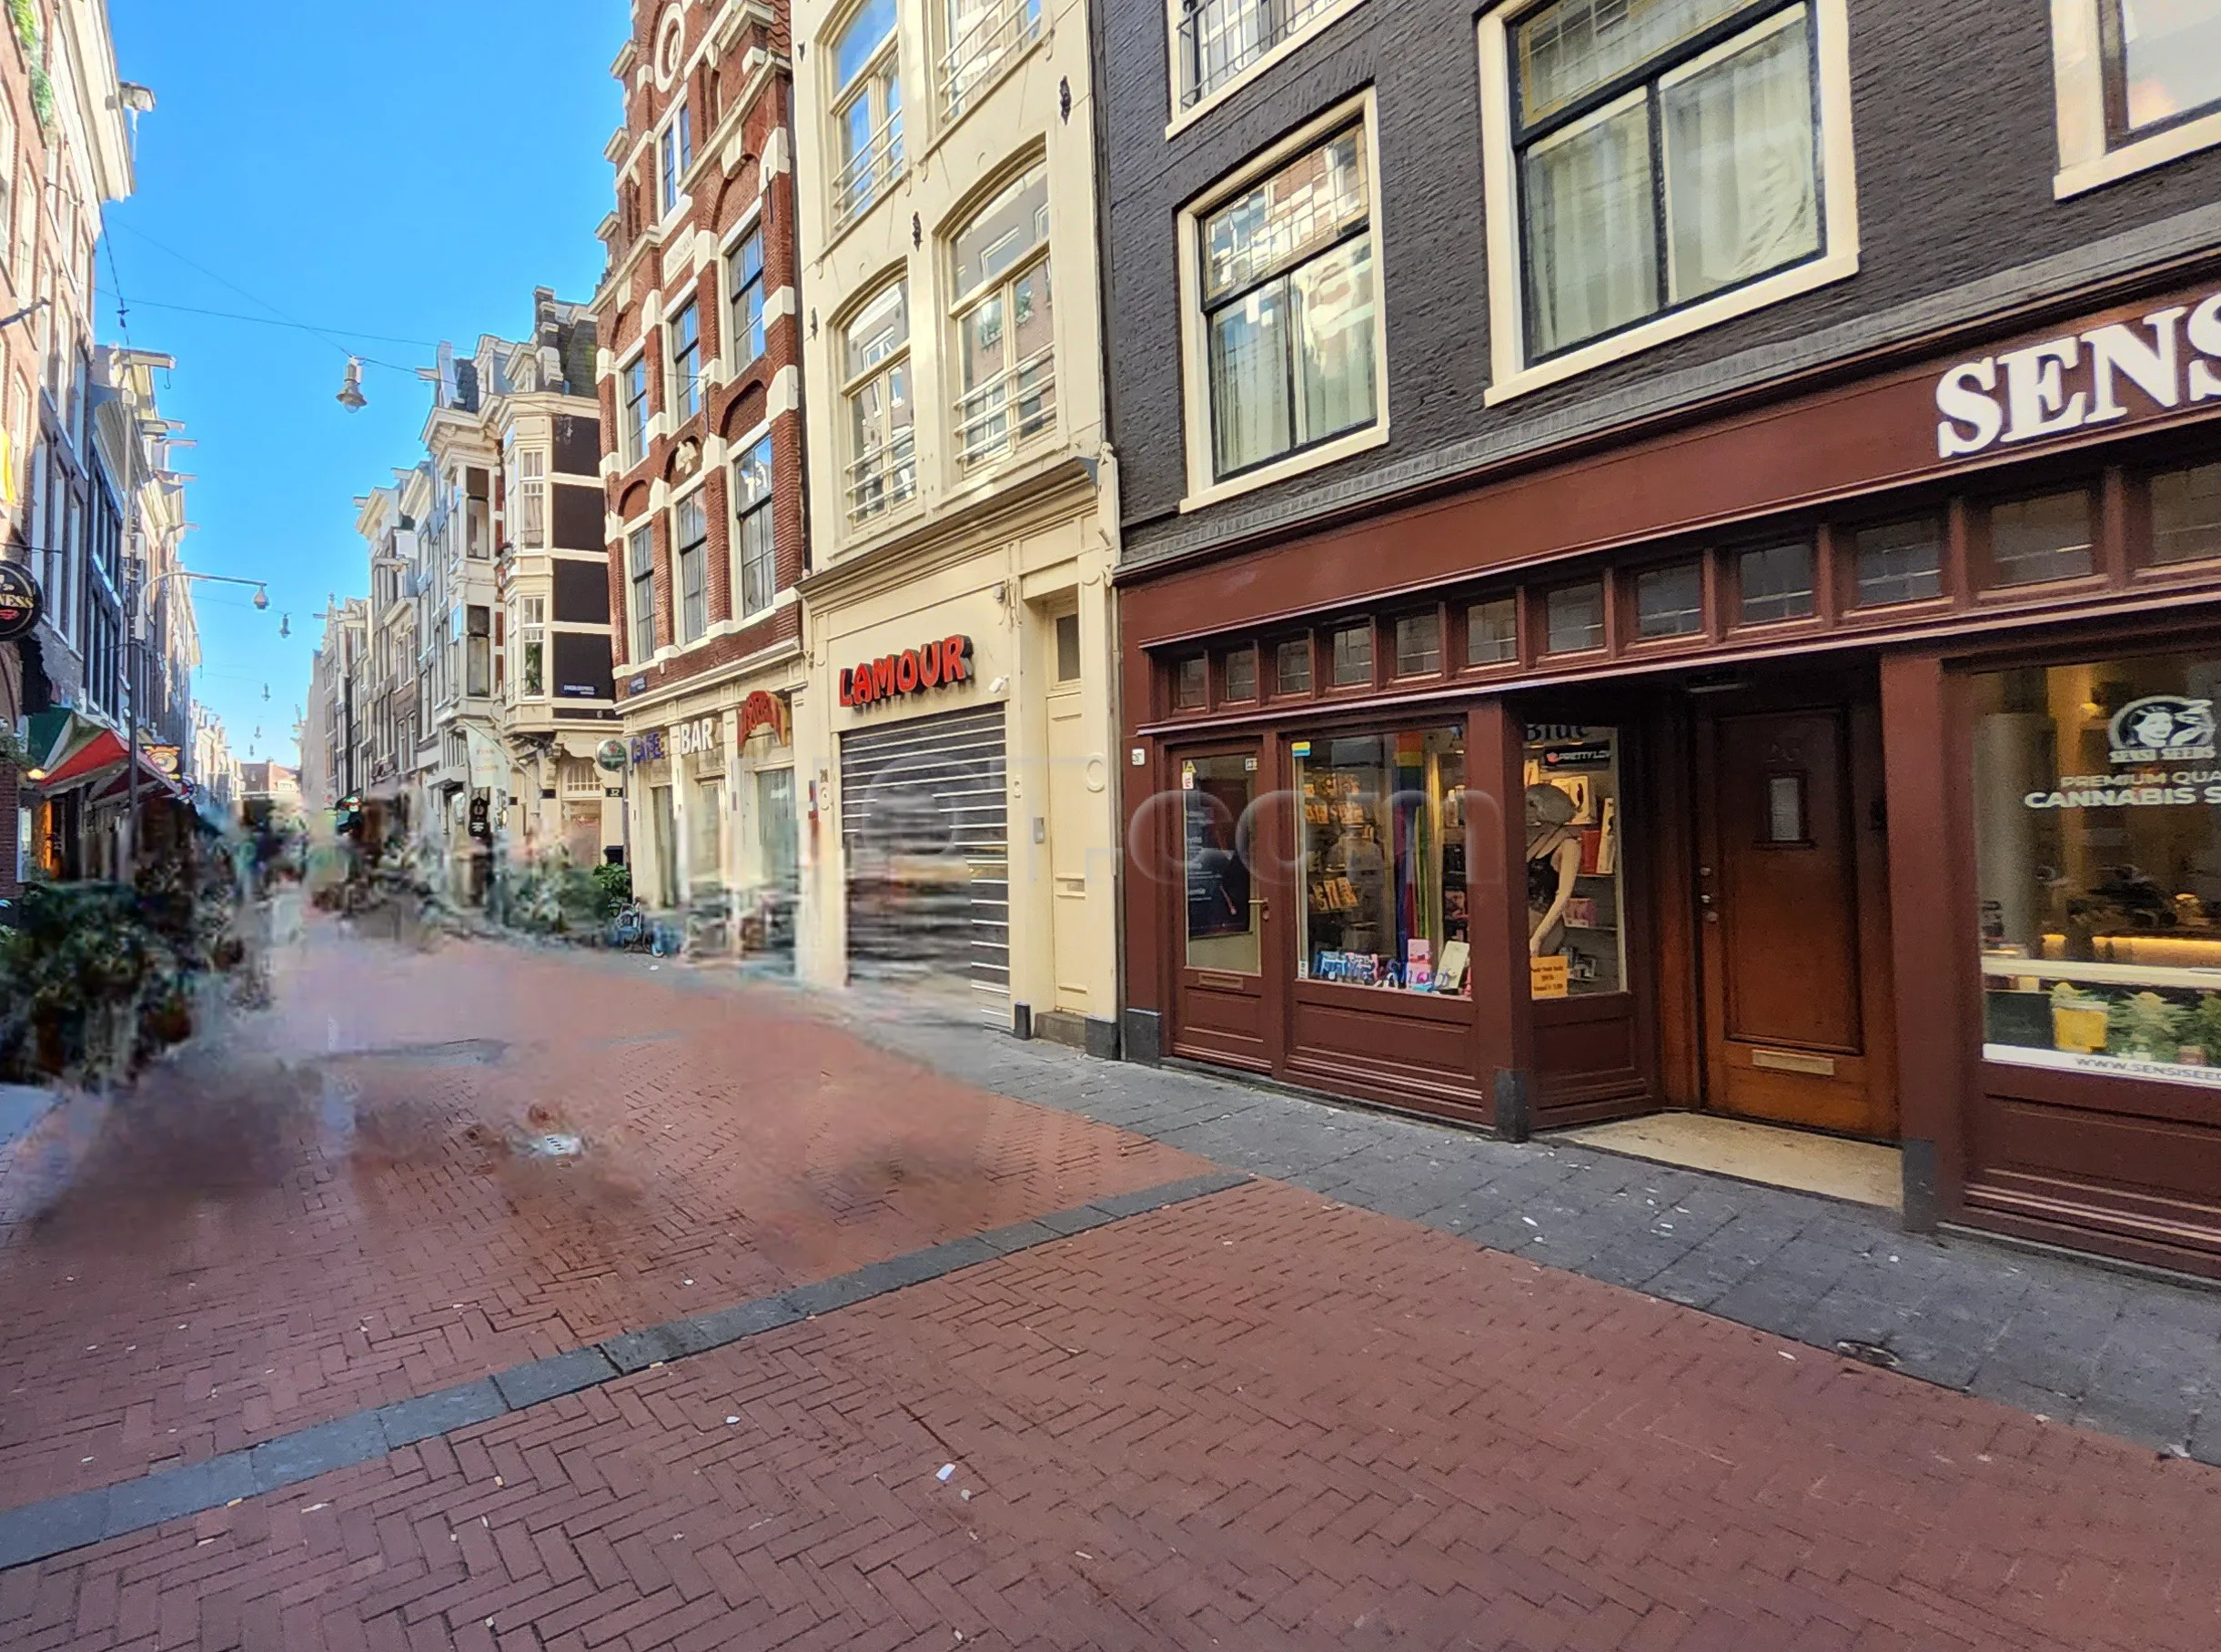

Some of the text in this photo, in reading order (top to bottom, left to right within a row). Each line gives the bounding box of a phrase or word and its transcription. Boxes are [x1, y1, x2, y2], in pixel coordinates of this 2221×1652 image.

[839, 634, 974, 707] LAMOUR
[681, 717, 714, 755] BAR
[2061, 773, 2166, 788] PREMIUM
[2024, 787, 2197, 809] CANNABIS
[2076, 1058, 2221, 1080] WWW.SENSISEE
